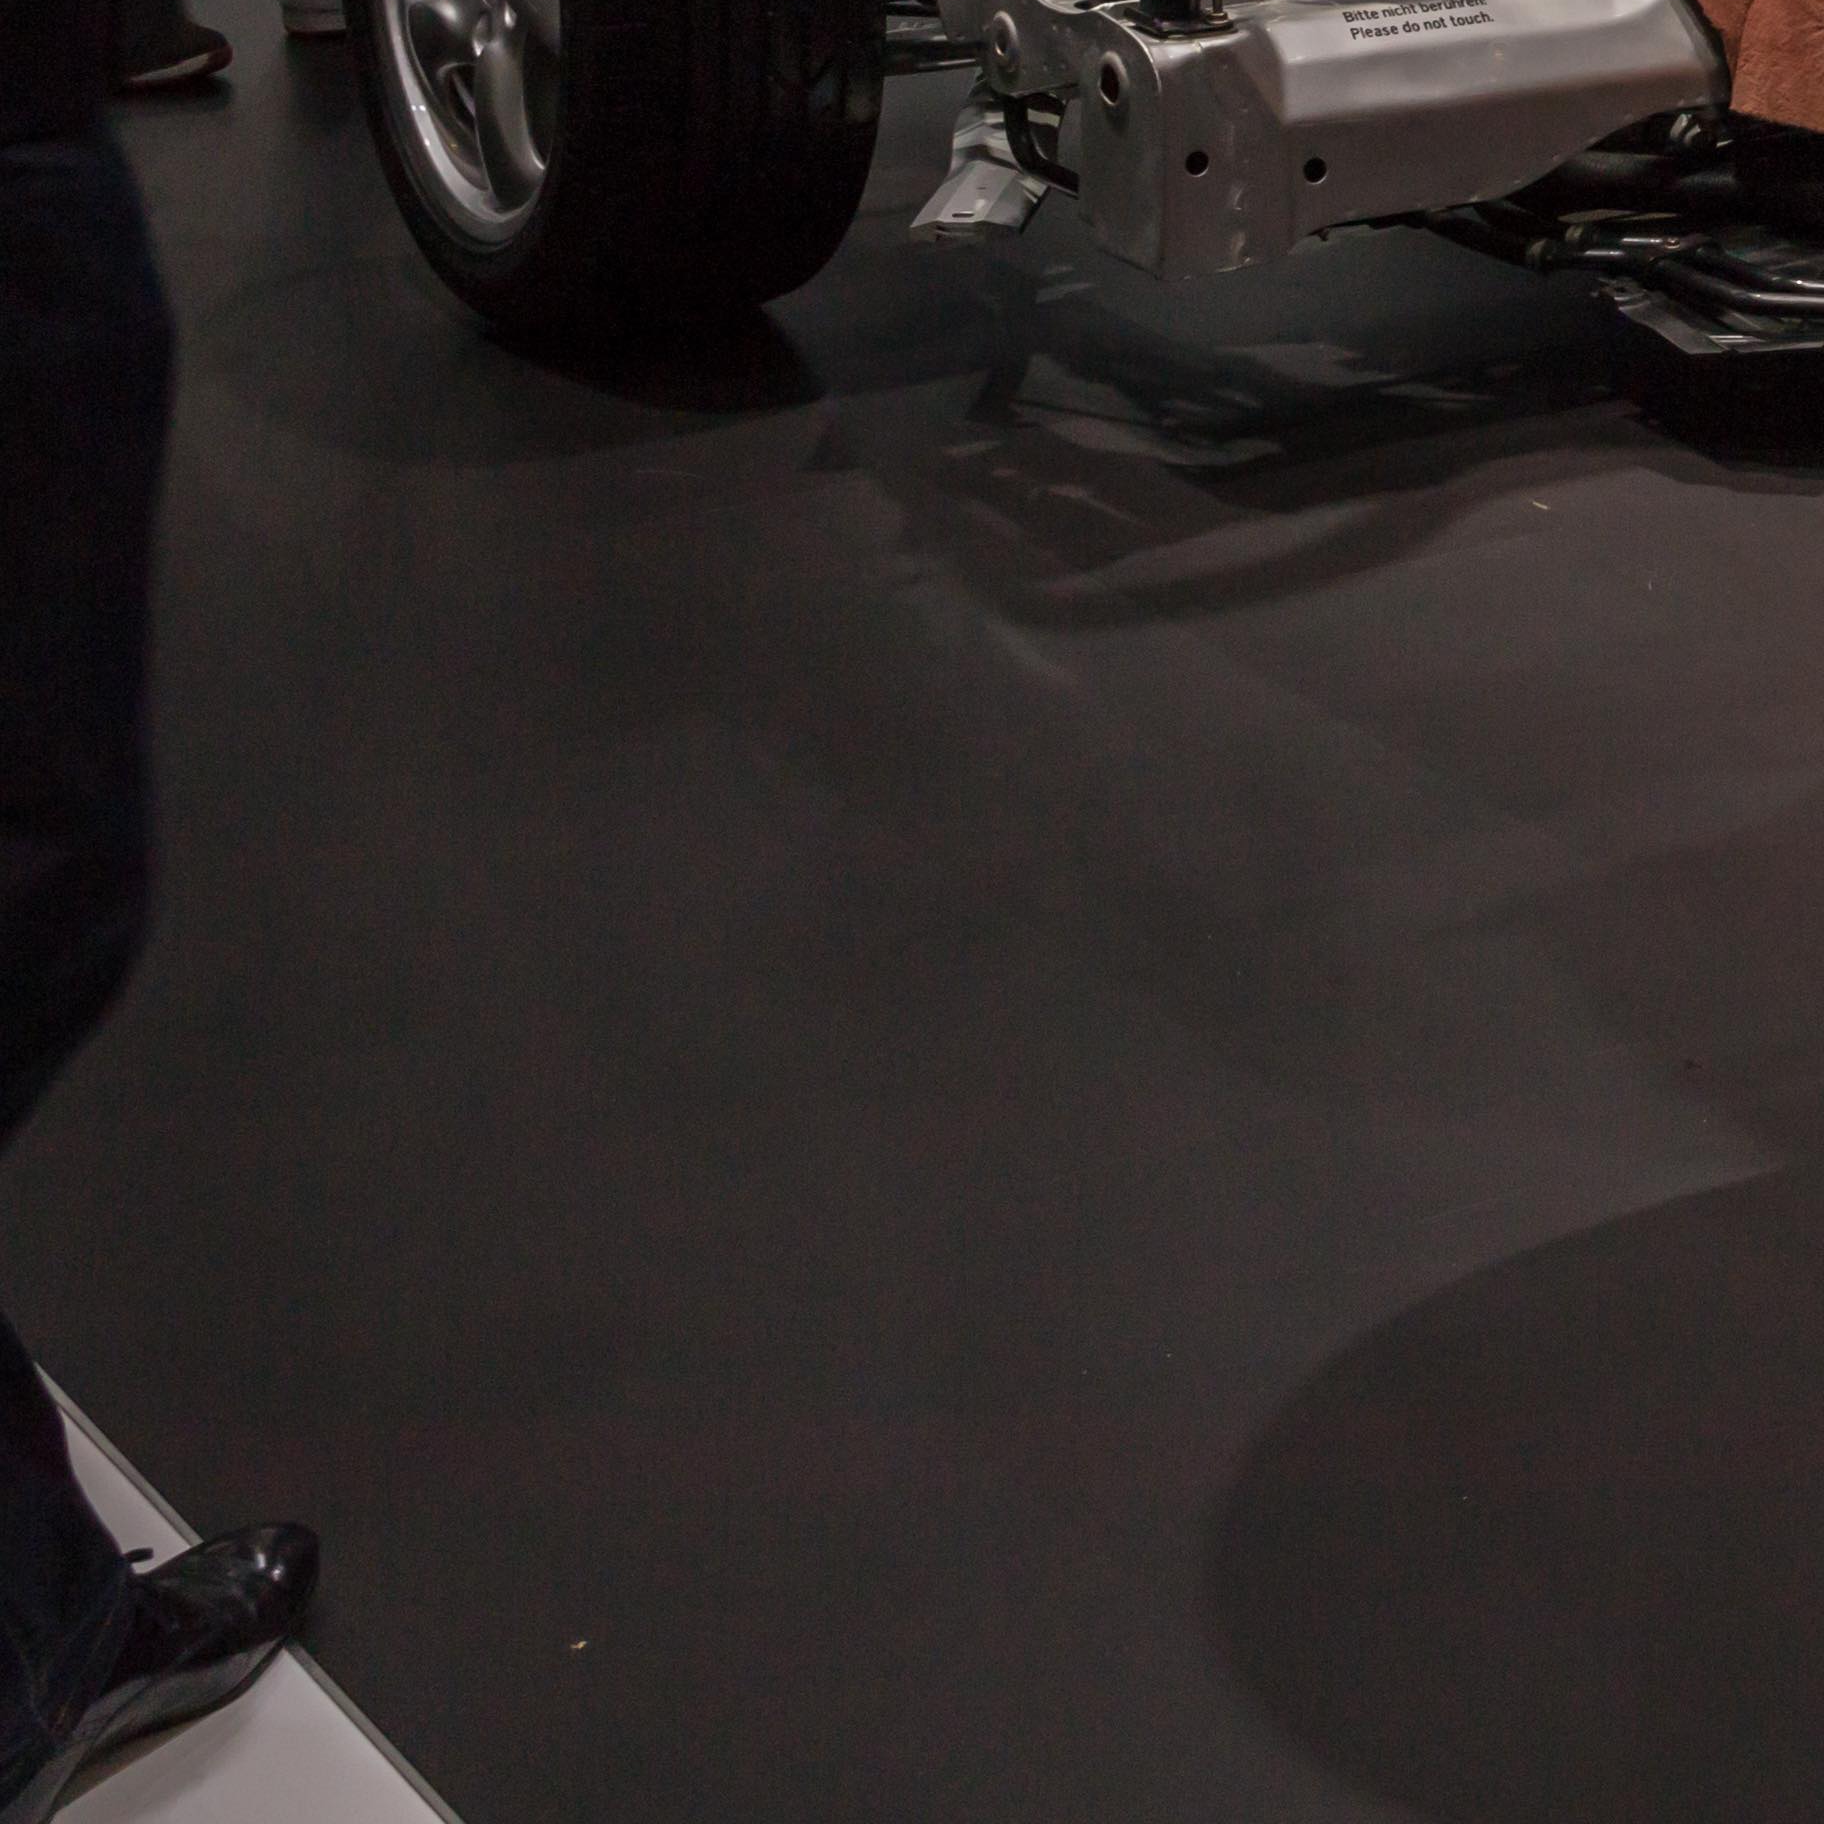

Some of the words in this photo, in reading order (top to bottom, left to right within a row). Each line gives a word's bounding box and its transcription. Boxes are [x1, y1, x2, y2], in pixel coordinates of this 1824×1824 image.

[1342, 10, 1379, 23] Bitte
[1382, 4, 1417, 19] nicht
[1350, 24, 1399, 40] Please
[1402, 20, 1421, 33] do
[1424, 16, 1448, 30] not
[1450, 10, 1495, 27] touch.
